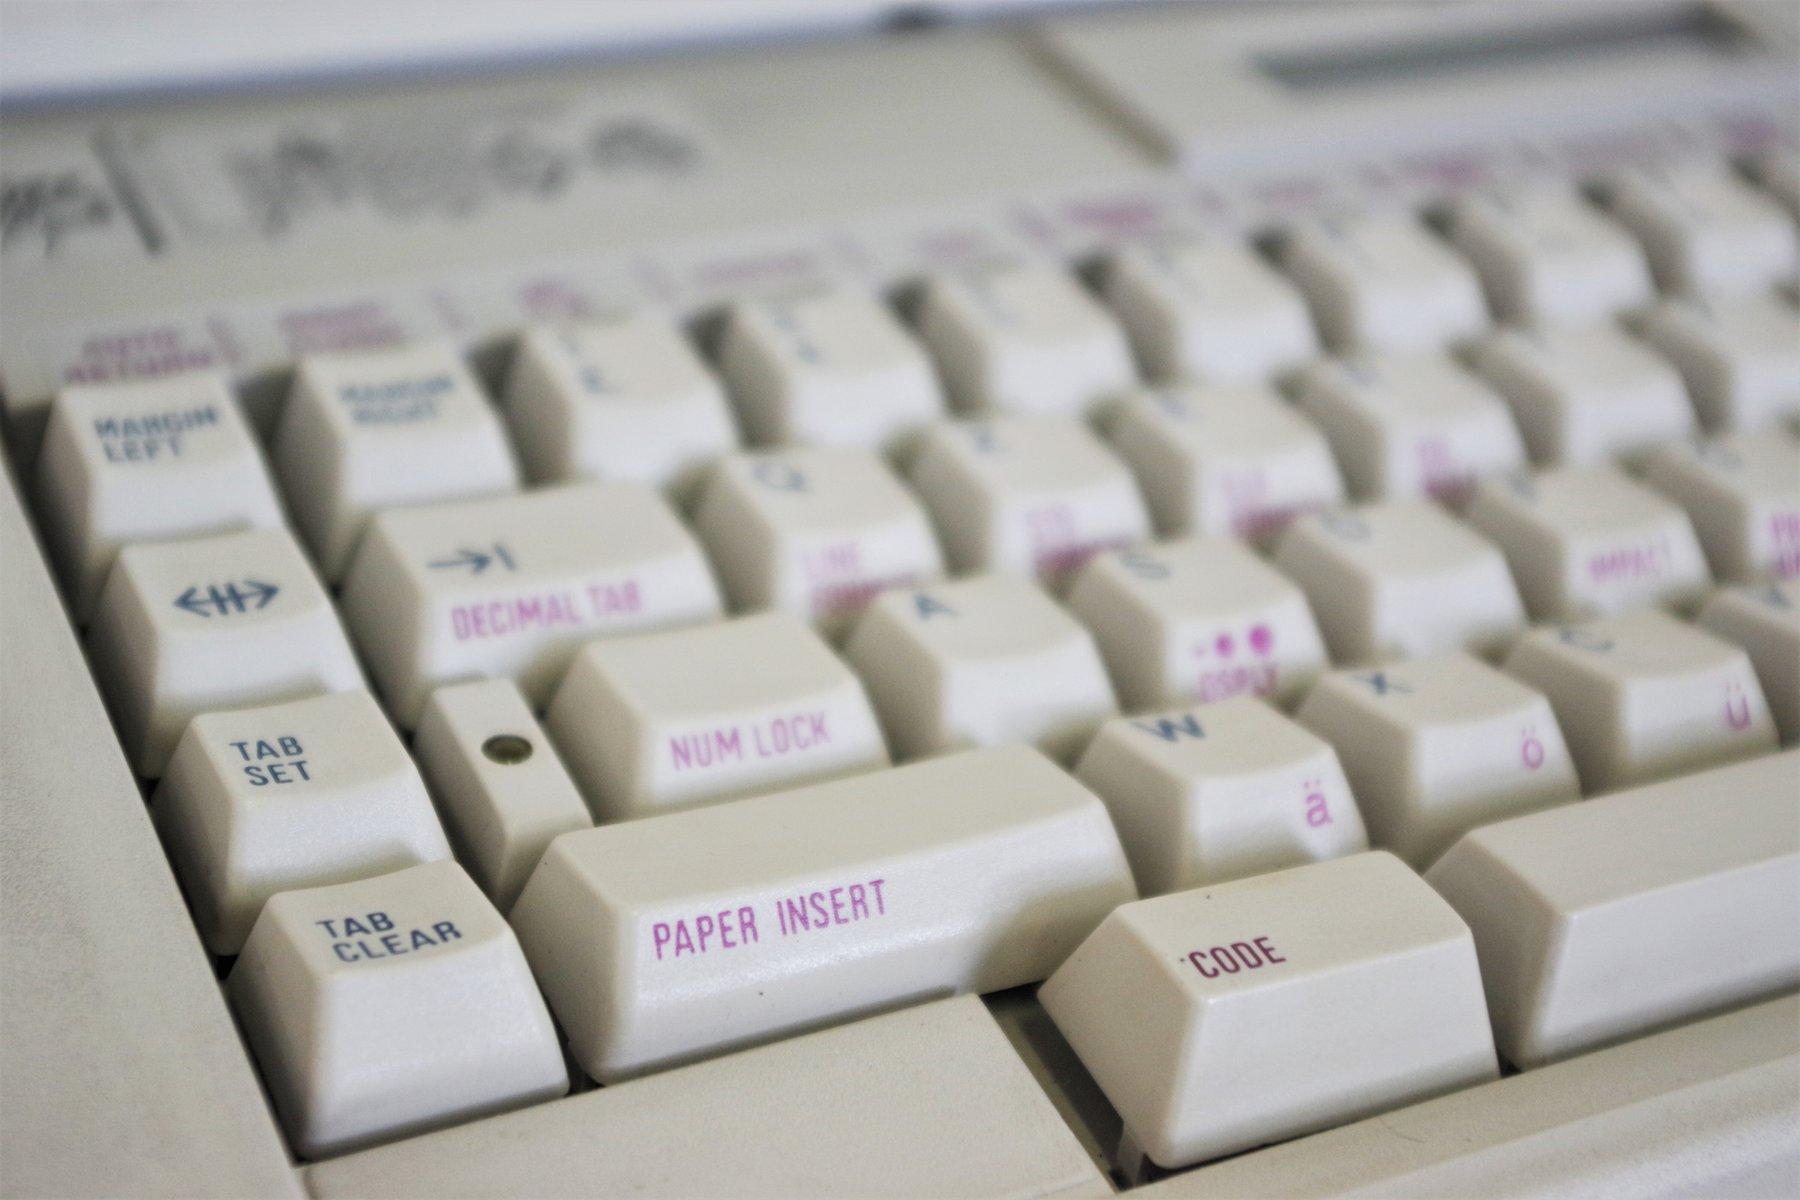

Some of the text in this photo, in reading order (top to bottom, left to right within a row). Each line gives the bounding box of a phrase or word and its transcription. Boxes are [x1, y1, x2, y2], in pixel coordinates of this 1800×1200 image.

[95, 407, 218, 437] MARGIN
[102, 435, 181, 463] LEFT
[451, 578, 640, 641] DECIMAL TAB
[669, 712, 831, 770] NUM LOCK
[1131, 713, 1206, 742] W
[230, 736, 304, 762] TAB
[1521, 726, 1545, 772] ö
[247, 760, 312, 786] SET
[1304, 778, 1332, 827] ä
[316, 911, 396, 940] TAB
[332, 920, 462, 963] CLEAR
[652, 879, 887, 962] PAPER INSERT
[1188, 936, 1287, 978] CODE
